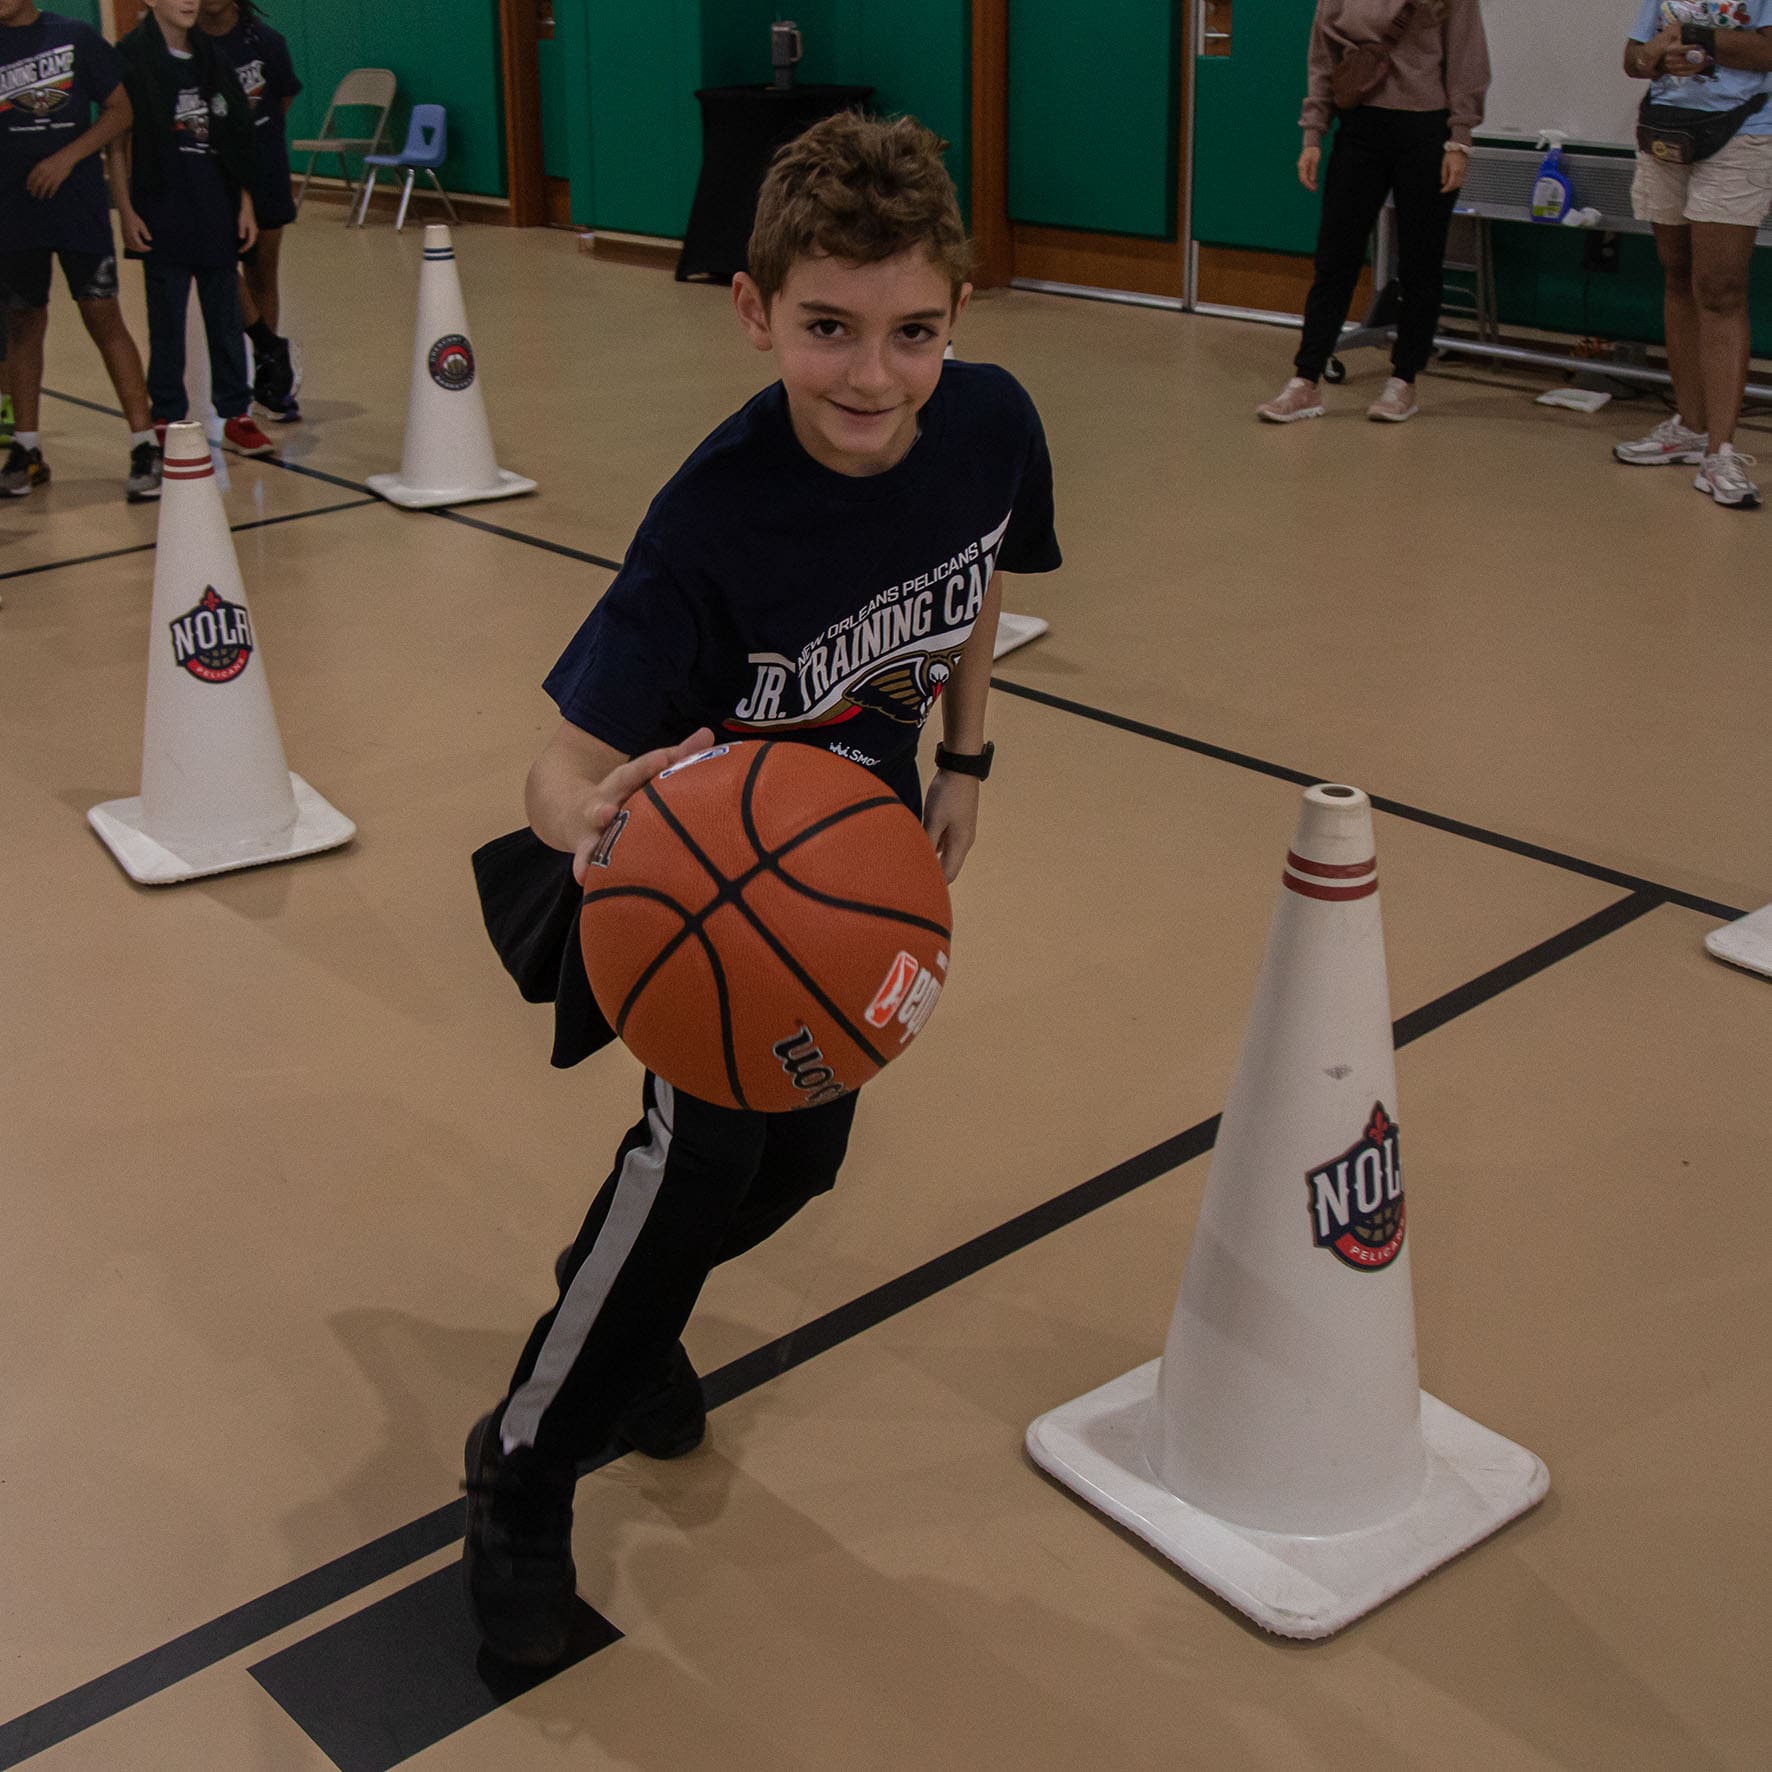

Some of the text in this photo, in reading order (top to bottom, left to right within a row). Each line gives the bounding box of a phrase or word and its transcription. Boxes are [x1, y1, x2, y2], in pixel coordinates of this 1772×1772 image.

[38, 51, 75, 79] CAMP
[172, 608, 252, 661] NOLA
[735, 665, 787, 720] JR.
[798, 590, 933, 712] TRAINING
[798, 542, 979, 669] NEW ORLEANS PELICANS
[1313, 1134, 1402, 1238] NOL
